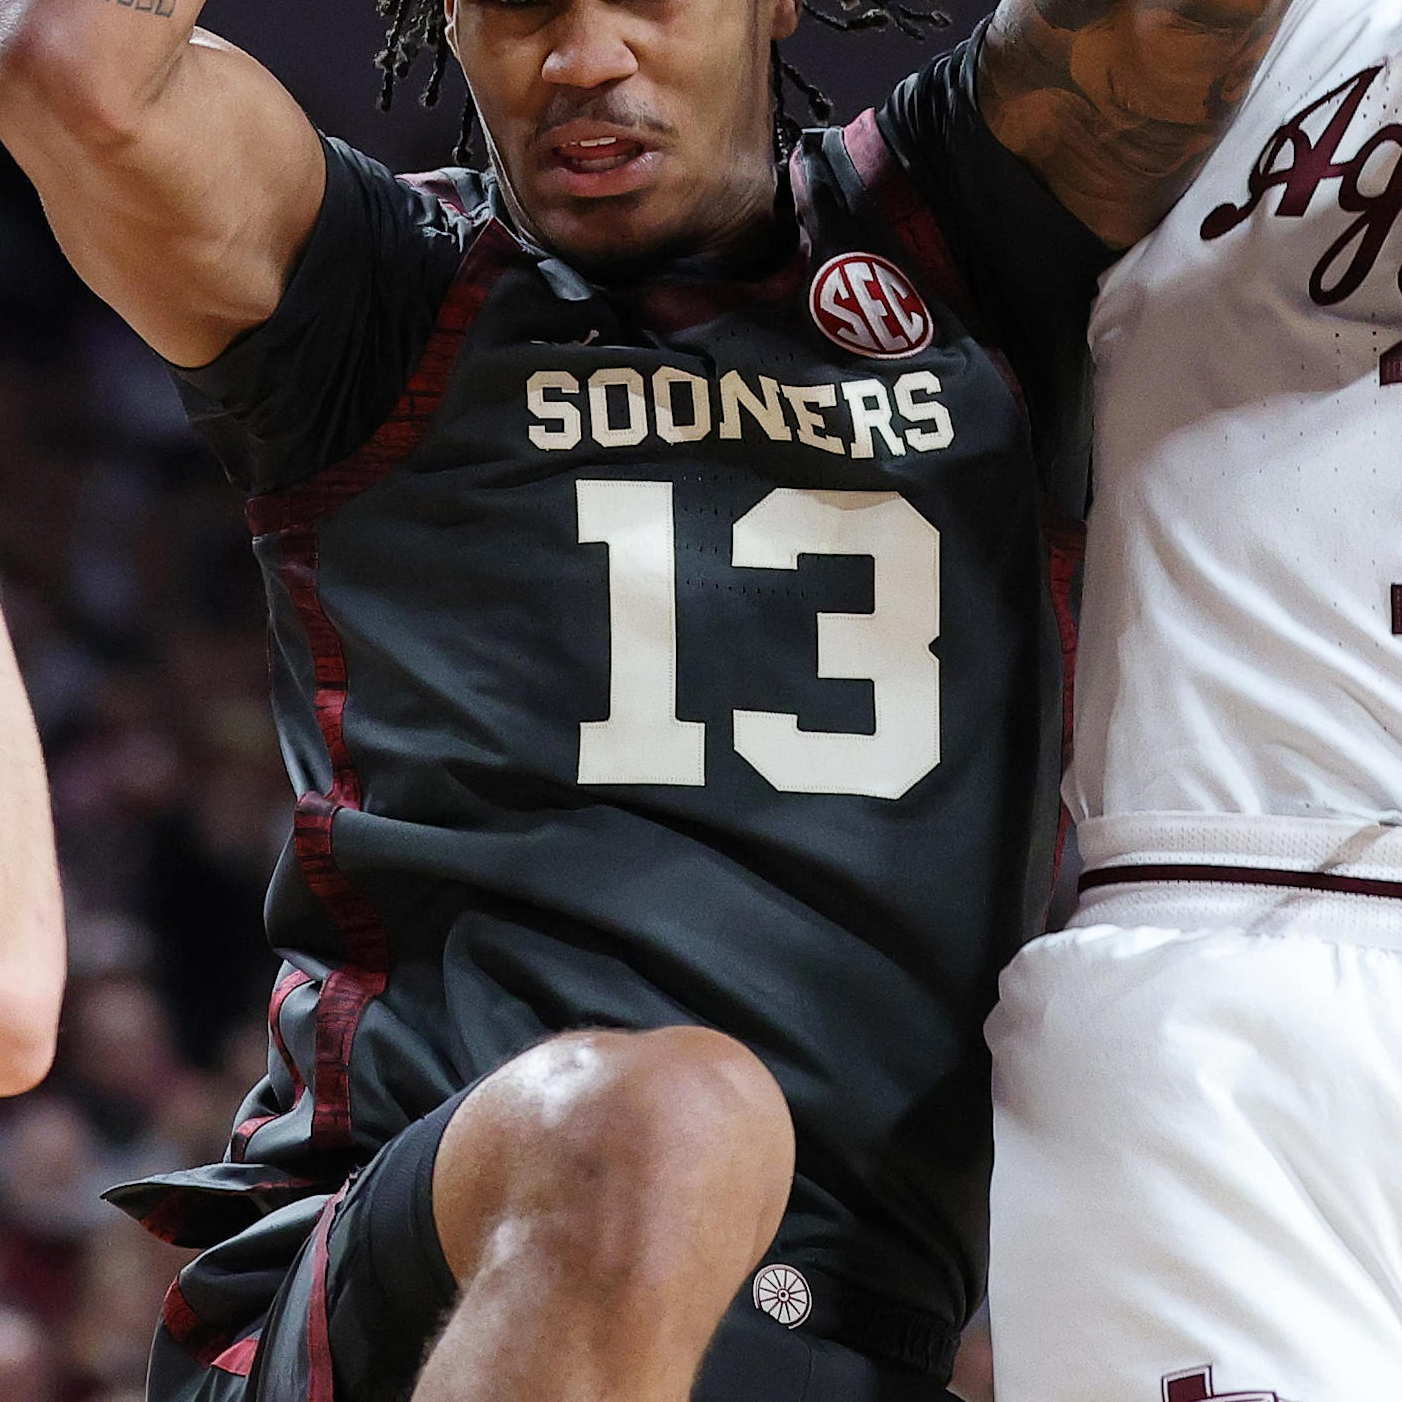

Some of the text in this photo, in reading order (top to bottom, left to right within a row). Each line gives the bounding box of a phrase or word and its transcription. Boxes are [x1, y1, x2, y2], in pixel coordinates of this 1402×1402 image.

[820, 261, 925, 351] SEC
[526, 366, 955, 459] SOONERS
[575, 479, 941, 800] 13
